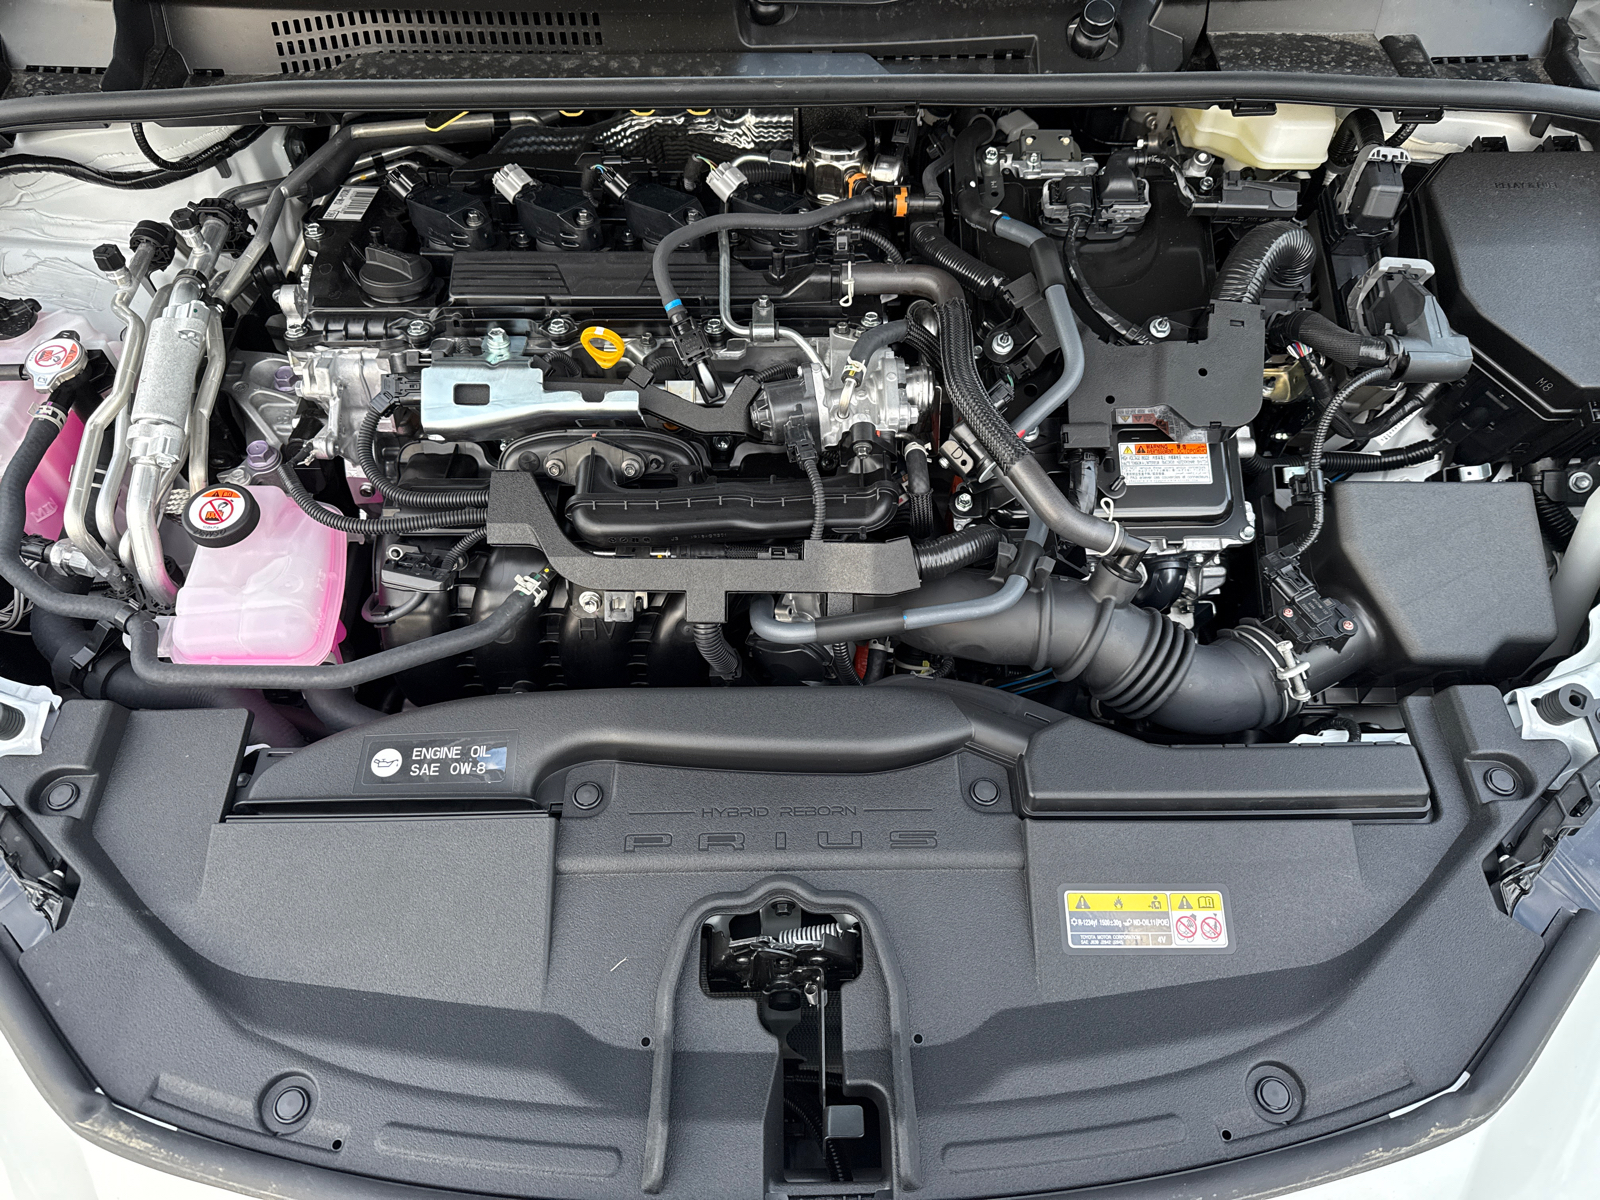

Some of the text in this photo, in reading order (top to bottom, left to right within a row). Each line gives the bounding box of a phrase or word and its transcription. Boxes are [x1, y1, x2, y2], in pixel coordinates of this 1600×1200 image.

[1535, 377, 1554, 392] M8
[411, 745, 491, 760] ENGINE OIL
[409, 762, 486, 776] SAE 0W-8
[701, 805, 857, 818] HYBRID REBORN
[623, 830, 938, 852] PRIUS
